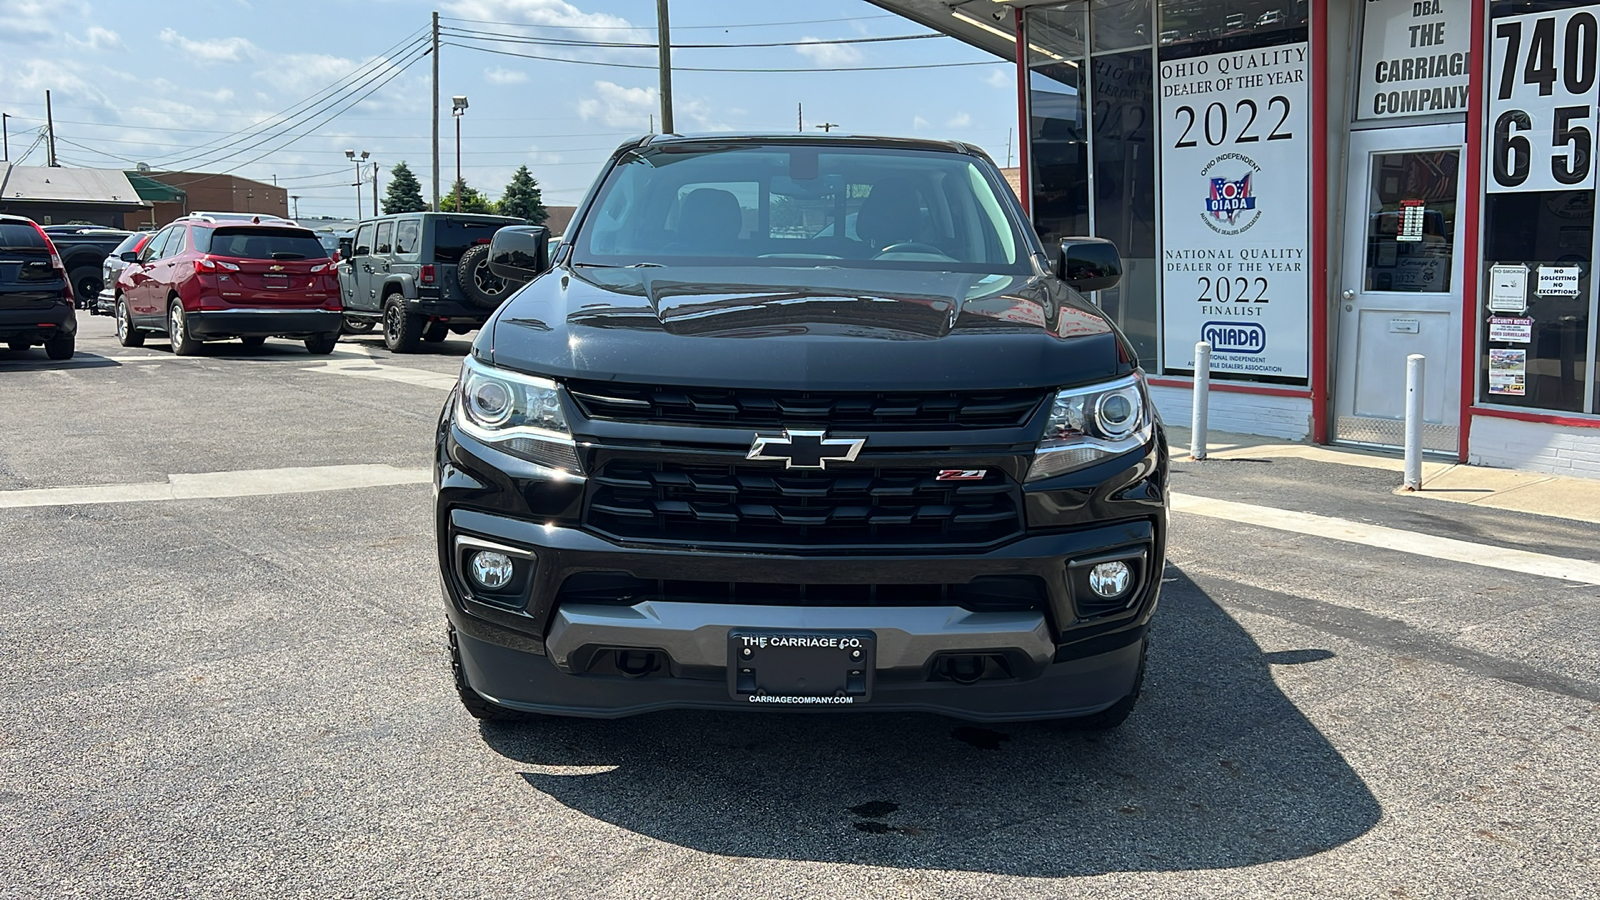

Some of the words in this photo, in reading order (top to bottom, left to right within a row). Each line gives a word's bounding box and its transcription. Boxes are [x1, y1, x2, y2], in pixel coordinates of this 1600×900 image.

[1412, 0, 1443, 17] DBA.
[1408, 22, 1446, 48] THE
[1161, 60, 1209, 79] OHIO
[1218, 47, 1307, 74] QUALITY
[1496, 11, 1598, 101] 740
[1164, 80, 1213, 98] DEALER
[1216, 77, 1233, 92] OF
[1236, 74, 1263, 89] THE
[1267, 69, 1304, 86] YEAR
[1373, 85, 1470, 115] COMPANY
[1174, 95, 1293, 149] 2022
[1200, 160, 1216, 177] OHIO
[1216, 153, 1262, 173] INDEPENDENT
[1211, 198, 1248, 211] OIADA
[1200, 212, 1221, 234] AUTOMOBILE
[1220, 228, 1240, 236] DEALERS
[1239, 209, 1262, 234] ASSOCIATION
[1165, 249, 1234, 259] NATIONAL
[1240, 248, 1304, 260] QUALITY
[1167, 262, 1213, 272] DEALER
[1217, 262, 1233, 272] OF
[1238, 262, 1263, 272] THE
[1268, 262, 1302, 272] YEAR
[1197, 276, 1270, 304] 2022
[1202, 305, 1263, 316] FINALIST
[1206, 328, 1260, 347] NIADA
[1229, 355, 1266, 363] INDEPENDENT
[1244, 364, 1282, 372] ASSOCIATION
[936, 469, 987, 480] Z71
[741, 636, 768, 648] THE
[770, 637, 838, 648] CARRIAGE
[839, 638, 863, 648] CO.
[748, 695, 854, 704] CARRIAGECOMPANY.COM
